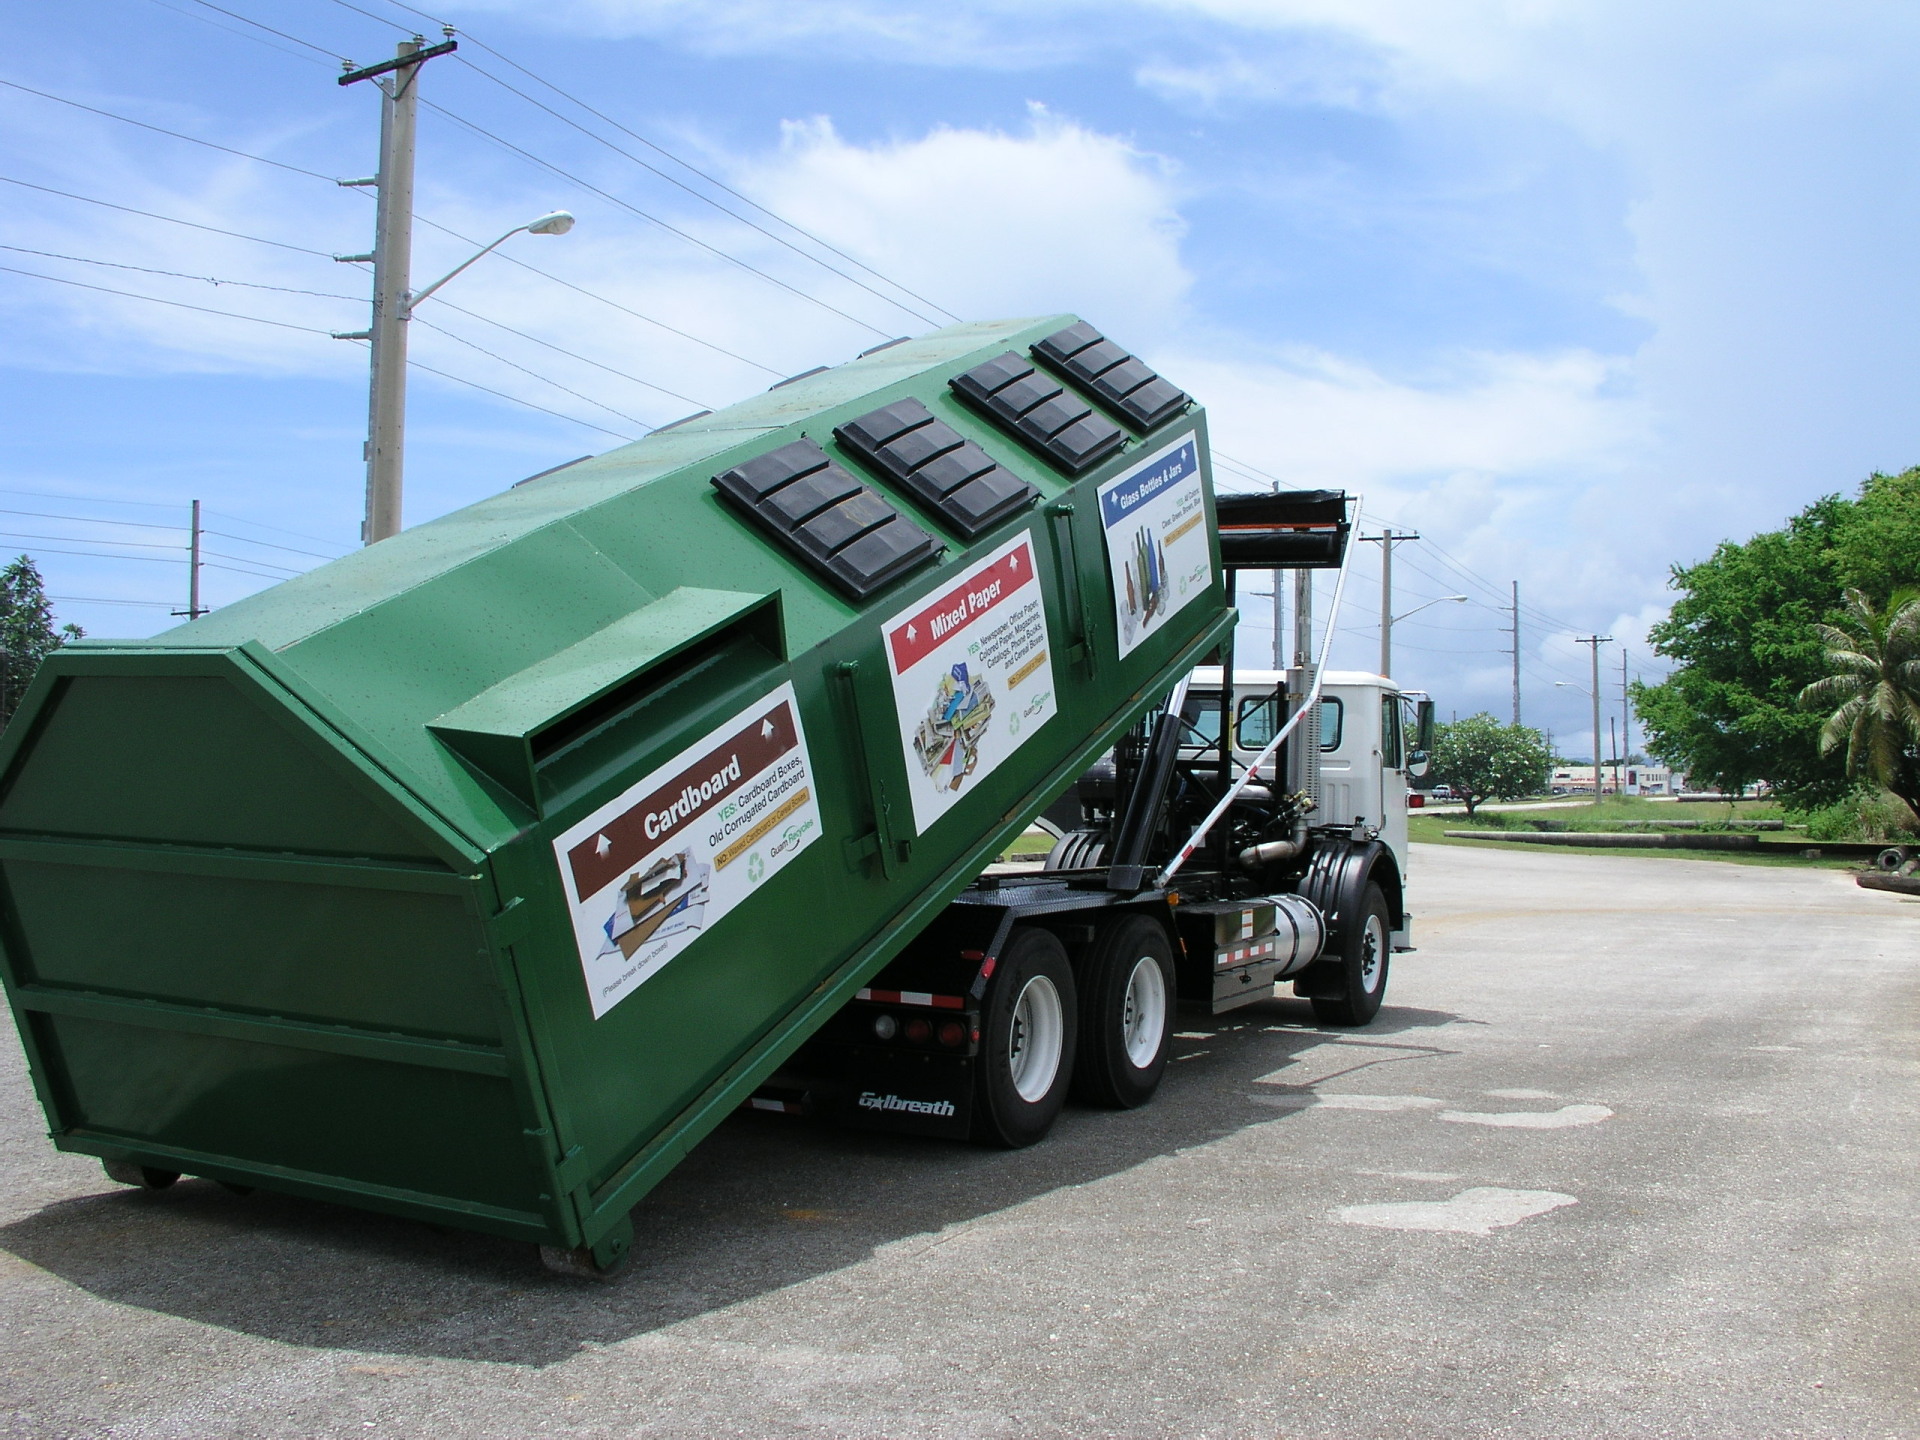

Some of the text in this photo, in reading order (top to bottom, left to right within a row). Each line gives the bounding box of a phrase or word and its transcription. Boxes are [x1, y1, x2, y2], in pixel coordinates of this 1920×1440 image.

[1120, 463, 1182, 509] Glass Bottles & Jars
[930, 579, 1000, 640] Mixed Paper
[1009, 609, 1024, 625] Office
[979, 641, 999, 661] Colored
[1004, 633, 1044, 670] and Cereal Boxes
[1011, 637, 1026, 655] Phone
[644, 754, 742, 840] Cardboard
[709, 767, 805, 847] Old Corrugated Cardboard
[718, 756, 803, 822] YES: Cardboard Boxes,
[717, 853, 728, 866] NO:
[746, 820, 772, 843] Cardboard
[771, 819, 813, 857] Guam Recycles
[602, 940, 669, 998] (Please break down boxes)
[859, 1091, 955, 1117] Galbreath
